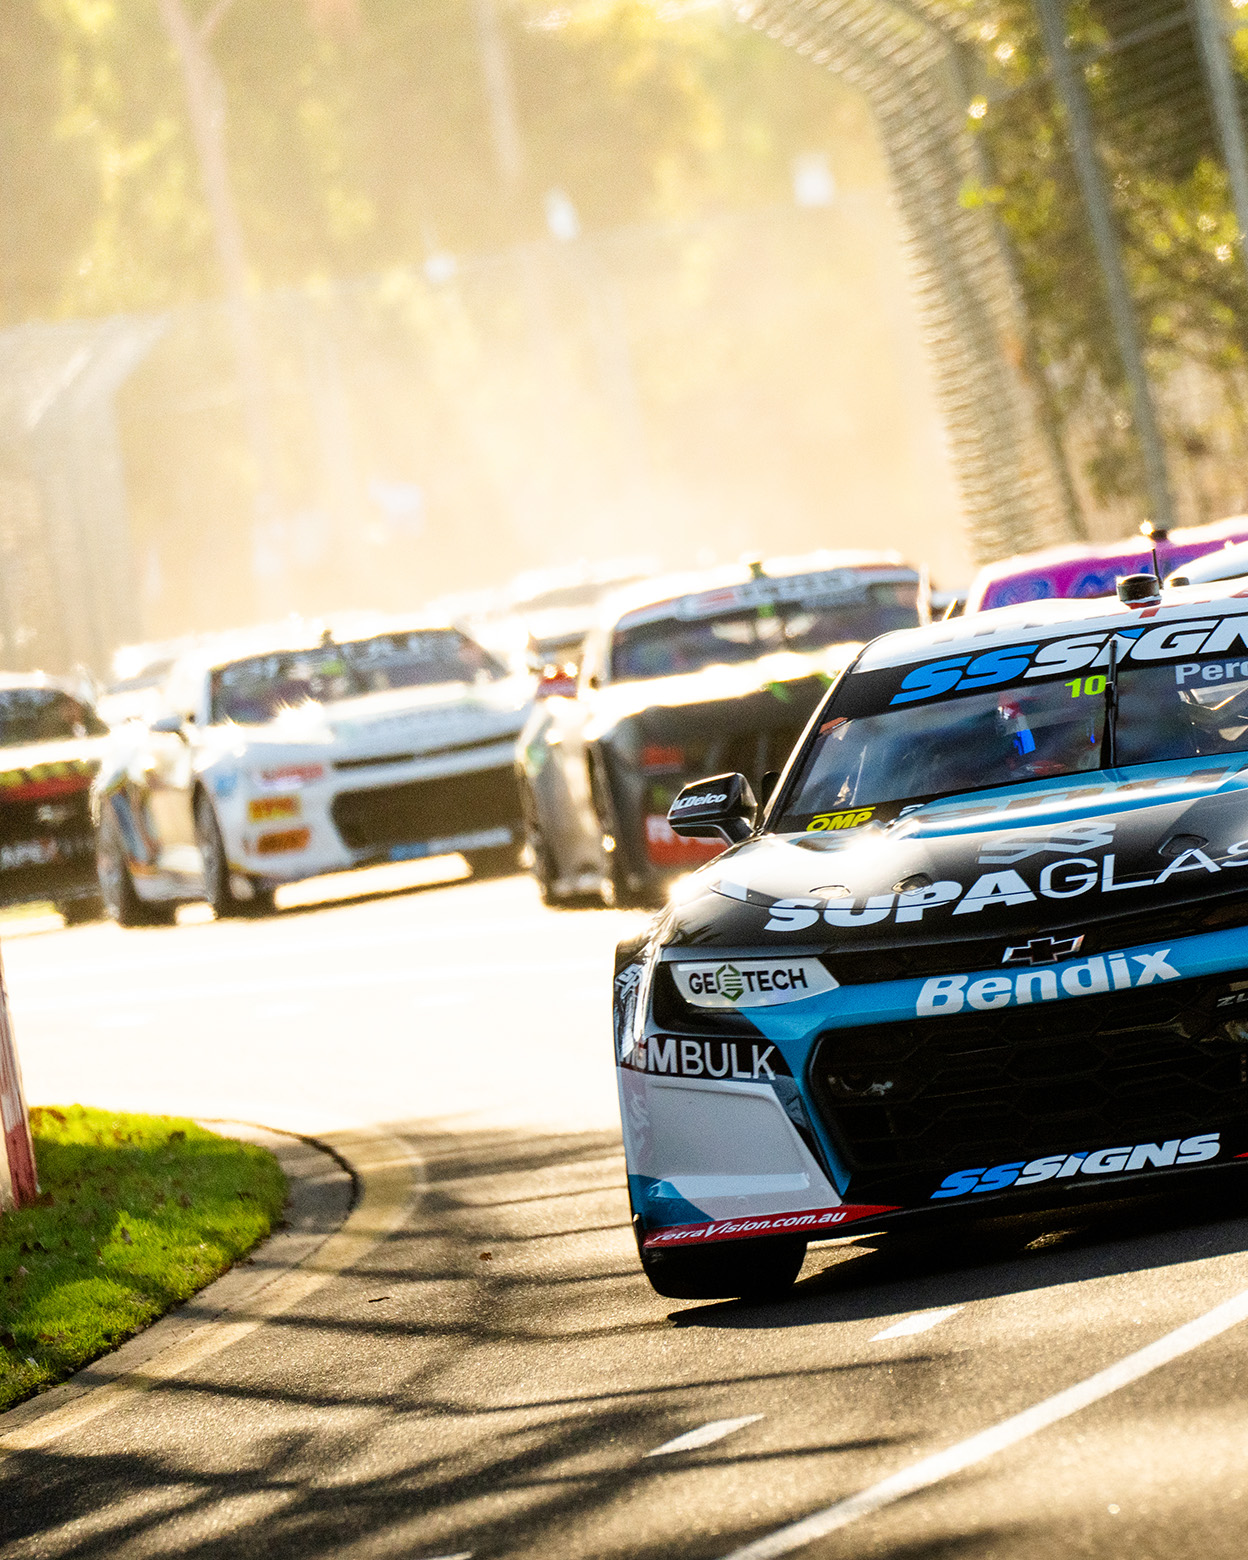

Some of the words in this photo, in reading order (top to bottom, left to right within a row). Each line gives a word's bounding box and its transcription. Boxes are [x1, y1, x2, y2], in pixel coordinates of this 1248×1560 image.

[1064, 672, 1107, 699] 10
[806, 811, 873, 832] OMP
[916, 948, 1181, 1017] Bendix
